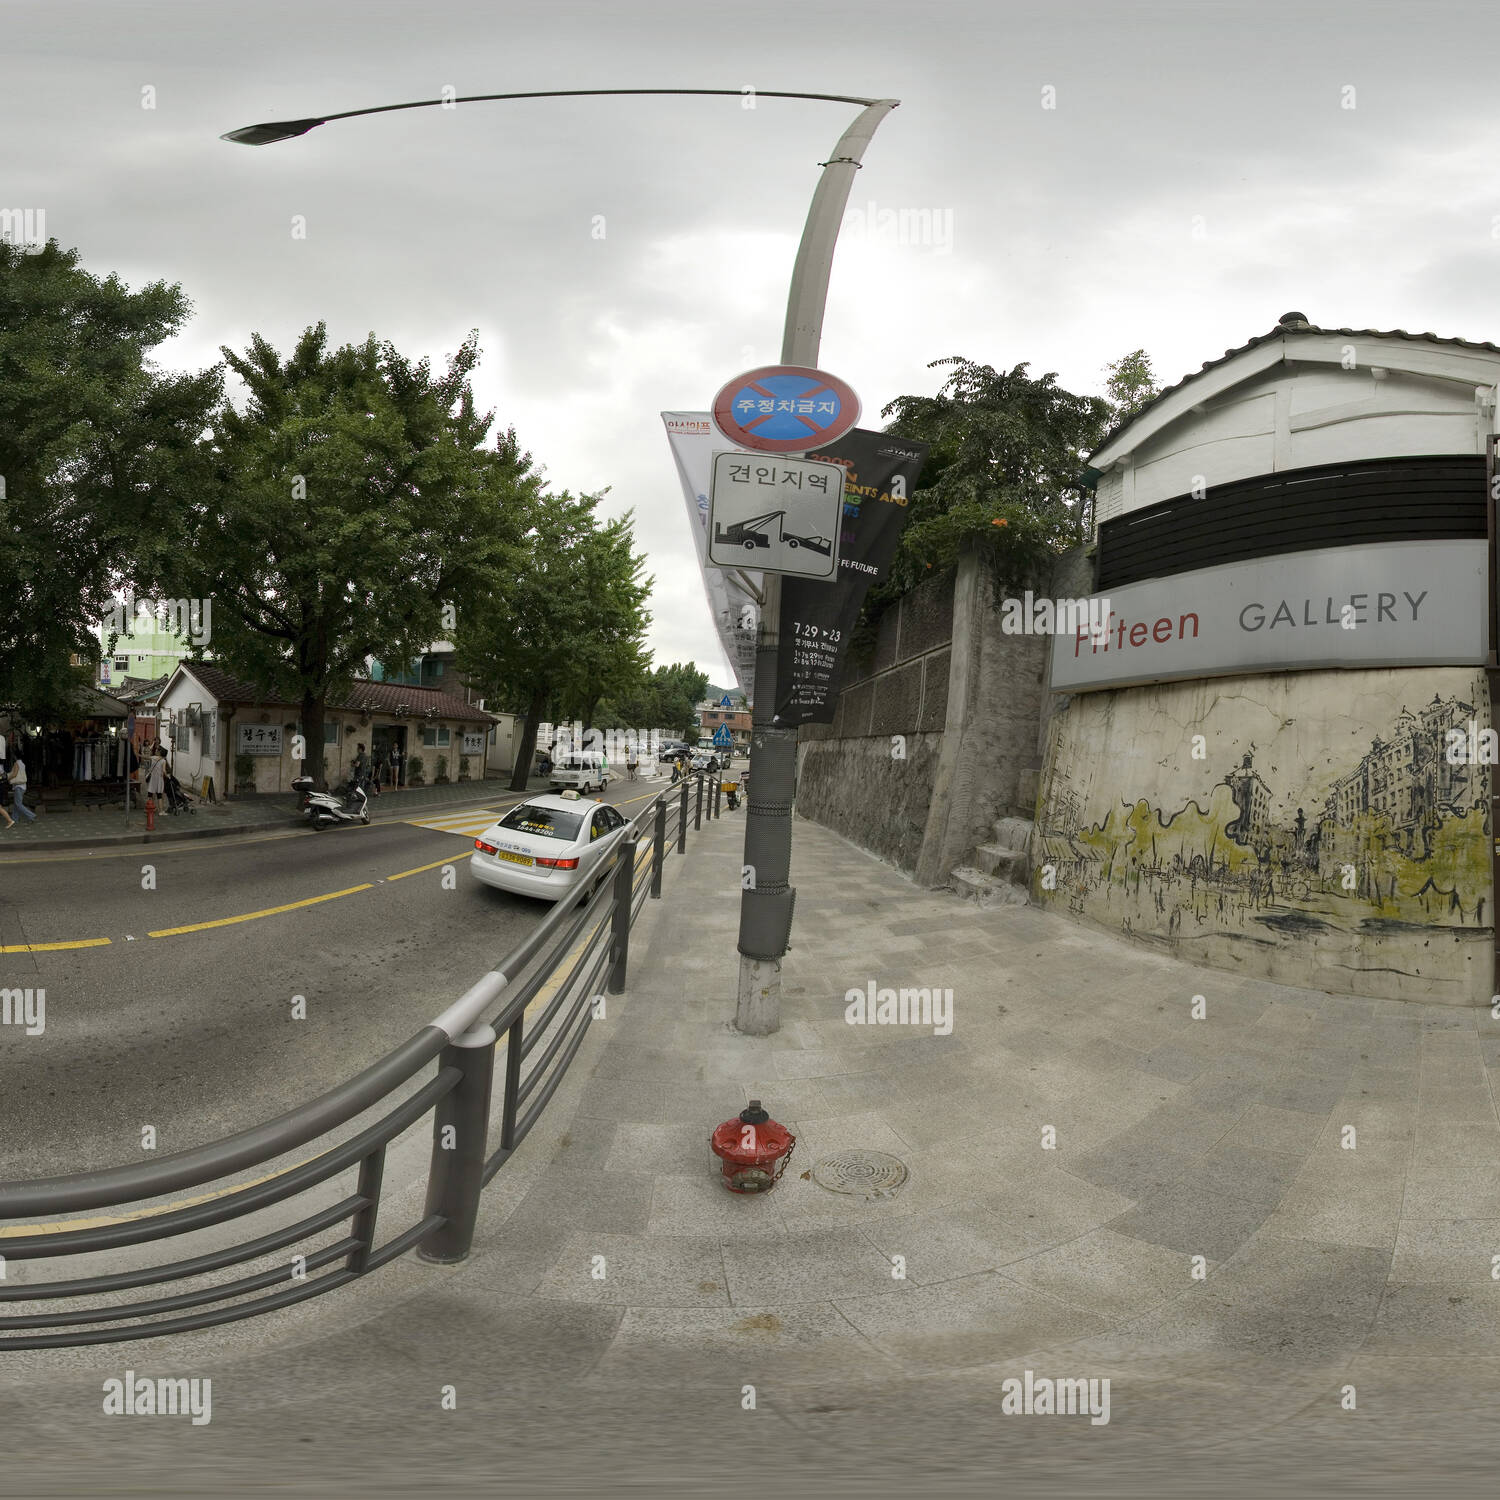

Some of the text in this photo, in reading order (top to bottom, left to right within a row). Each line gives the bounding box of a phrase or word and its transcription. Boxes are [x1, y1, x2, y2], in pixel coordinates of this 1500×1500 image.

[737, 399, 836, 415] 주정차금지
[667, 420, 711, 431] 아시아프
[728, 463, 829, 494] 견인지역
[851, 559, 879, 576] FUTURE
[794, 622, 819, 638] 7.29
[1074, 591, 1429, 658] Fifteen GALLERY
